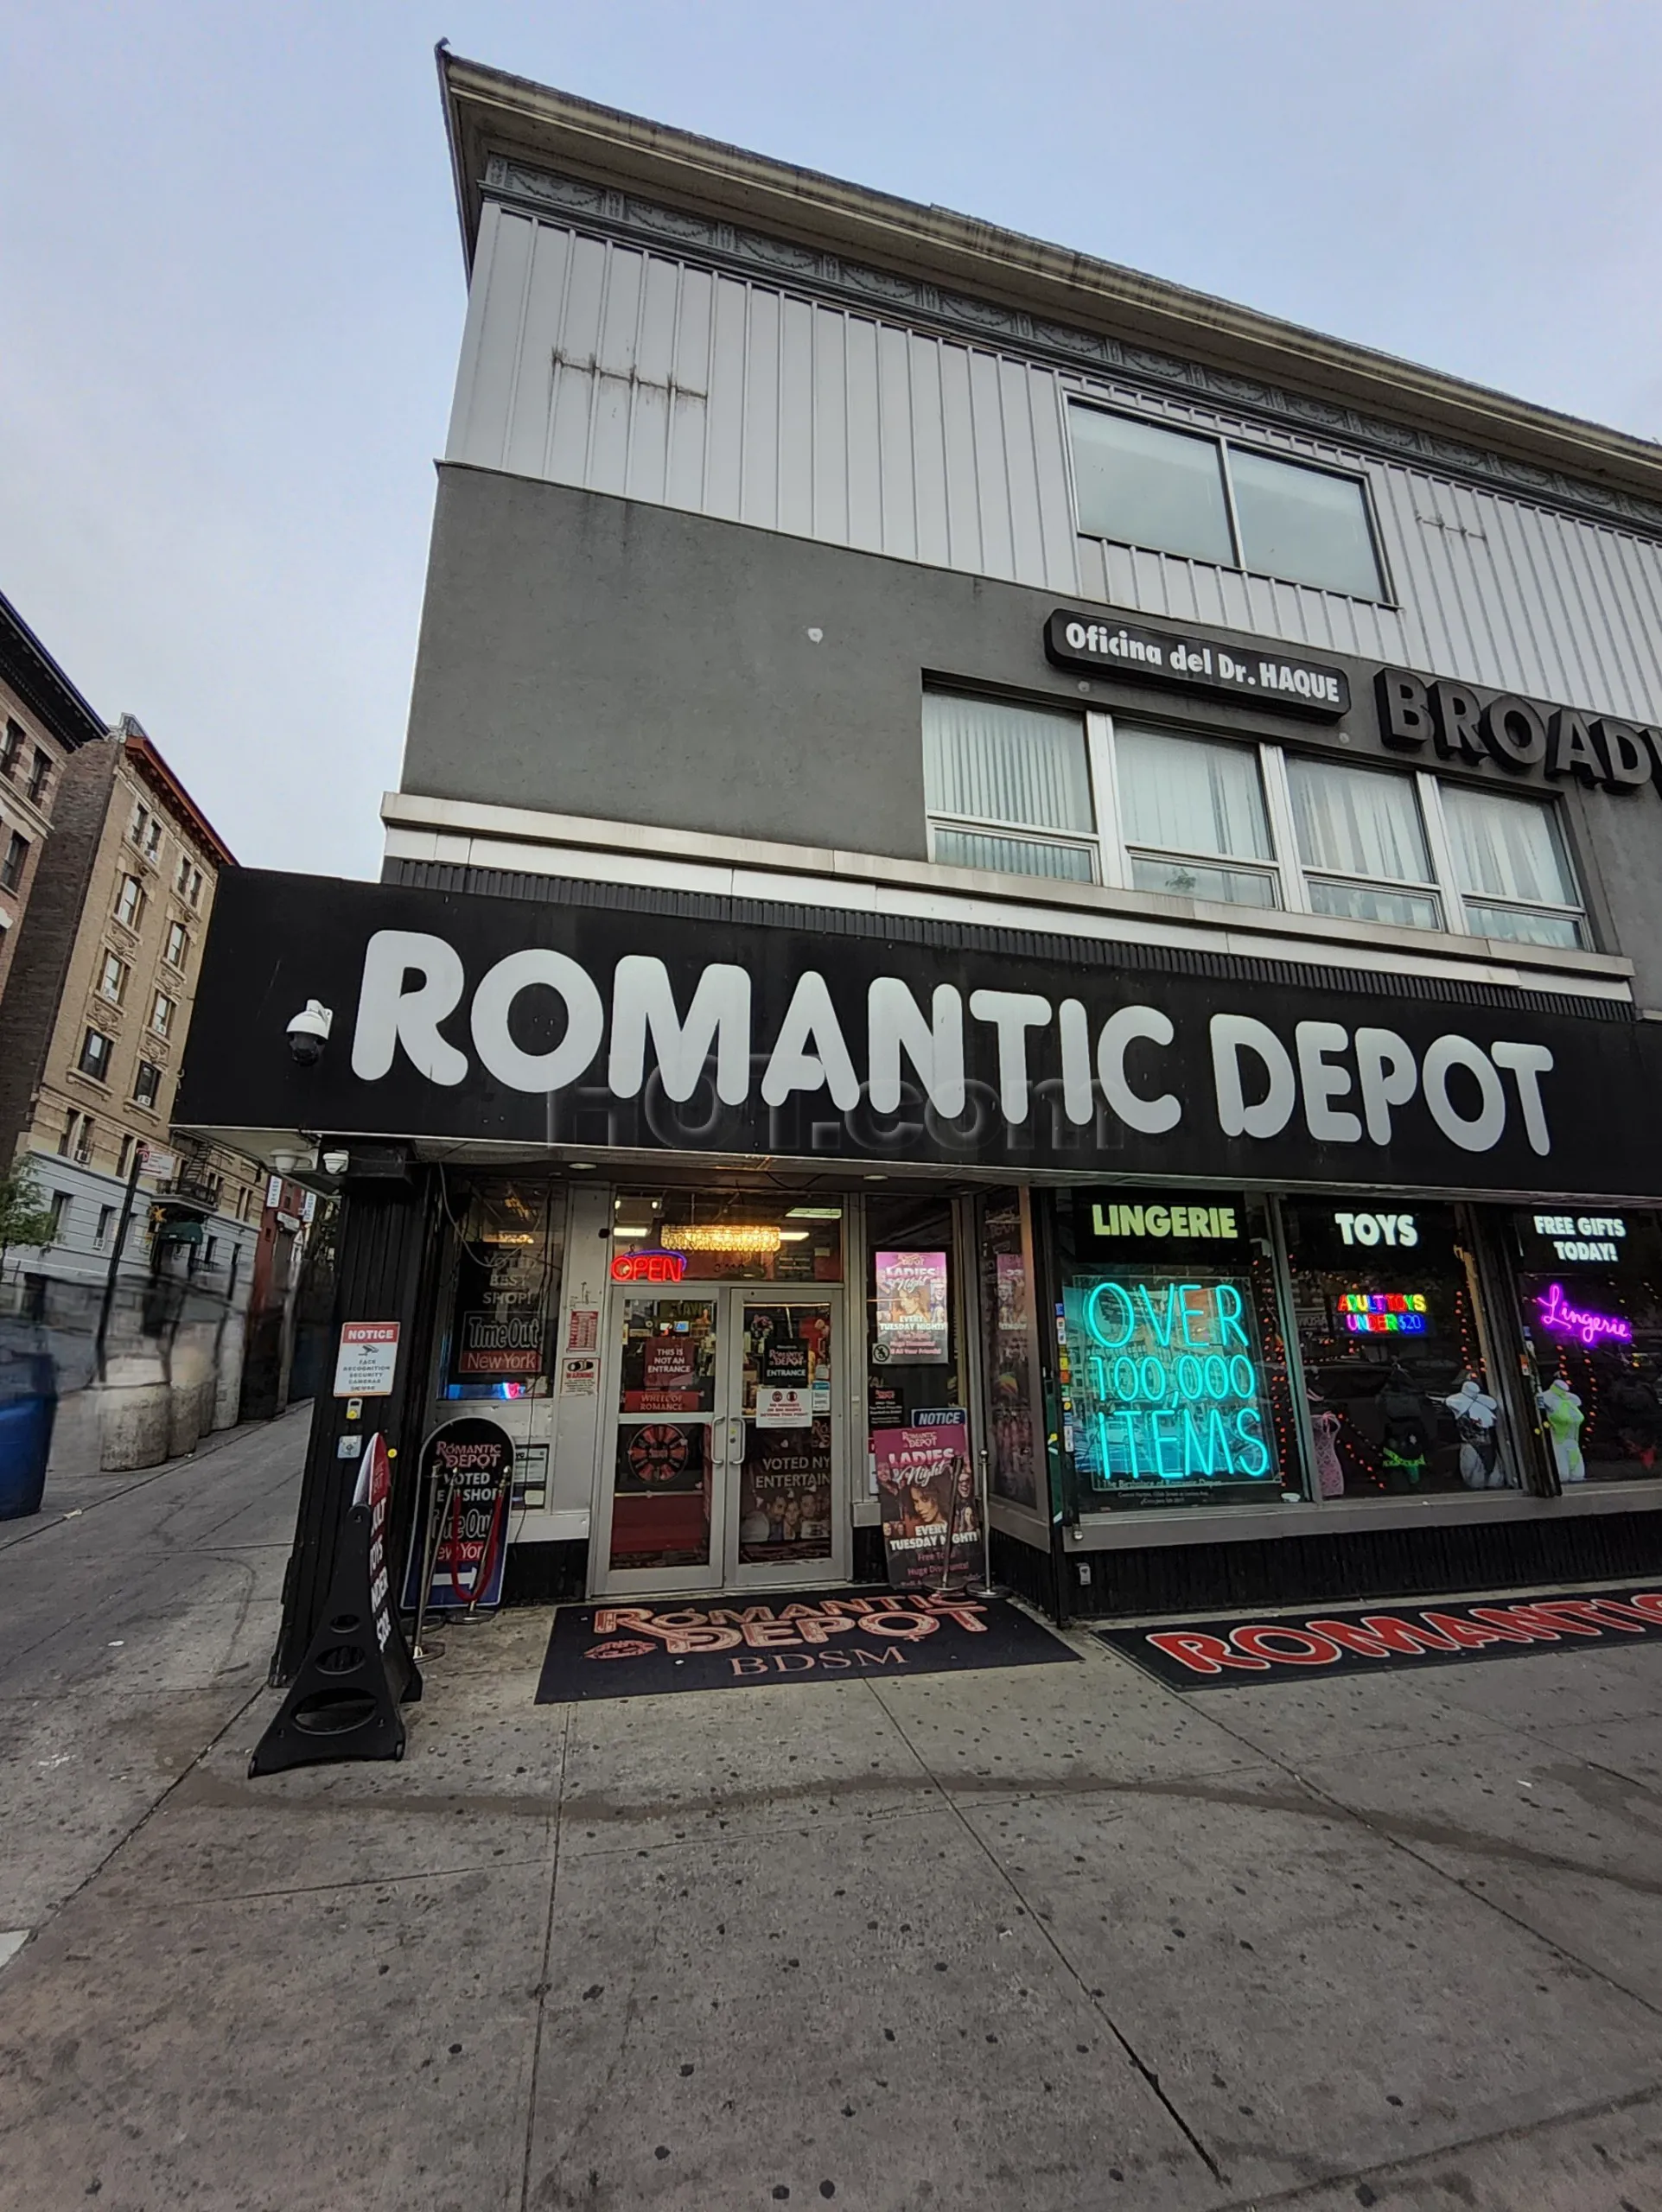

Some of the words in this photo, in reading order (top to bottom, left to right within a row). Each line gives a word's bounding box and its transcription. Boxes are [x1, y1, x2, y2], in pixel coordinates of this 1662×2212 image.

[1065, 621, 1163, 666] Oficina
[1169, 643, 1213, 676] del
[1218, 653, 1256, 689] Dr.
[1259, 662, 1340, 703] HAQUE
[1376, 668, 1662, 794] BROAD
[351, 929, 1182, 1134] ROMANTIC
[1209, 1013, 1554, 1157] DEPOT
[1092, 1205, 1239, 1238] LINGERIE
[1334, 1212, 1419, 1247] TOYS
[1533, 1215, 1576, 1236] FREE
[1578, 1217, 1627, 1238] GIFTS
[1553, 1241, 1619, 1262] TODAY!
[611, 1255, 683, 1283] OPEN
[886, 1267, 937, 1277] LADIES
[488, 1274, 530, 1287] BEST
[1338, 1294, 1386, 1313] ADULT
[1386, 1294, 1428, 1313] TOYS
[1536, 1282, 1633, 1344] Lingerie
[1086, 1282, 1250, 1348] OVER
[1346, 1313, 1398, 1333] UNDER
[1398, 1314, 1423, 1333] $20
[347, 1330, 394, 1340] NOTICE
[880, 1323, 915, 1332] TUESDAY
[466, 1352, 502, 1370] New
[500, 1352, 538, 1370] York
[654, 1357, 671, 1365] NOT
[672, 1357, 685, 1365] AN
[657, 1348, 672, 1357] THIS
[674, 1348, 684, 1357] IS
[647, 1364, 691, 1374] ENTRANCE
[766, 1369, 806, 1377] ENTRANCE
[1088, 1354, 1256, 1409] 100,000
[640, 1402, 684, 1412] ROMANCE
[641, 1394, 669, 1403] WHEEL
[671, 1394, 683, 1402] OF
[919, 1411, 961, 1426] NOTICE
[435, 1440, 501, 1457] ROMANTIC
[908, 1438, 938, 1448] DEPOT
[1098, 1408, 1270, 1480] ITEMS
[446, 1452, 501, 1469] DEPOT
[762, 1455, 810, 1471] VOTED
[888, 1447, 955, 1466] LADIES
[443, 1471, 491, 1486] VOTED
[914, 1523, 948, 1536] EVERY
[889, 1535, 938, 1551] TUESDAY
[939, 1531, 978, 1547] NGHT!
[460, 1542, 485, 1561] Yor
[594, 1592, 978, 1642] ROMANTIC
[665, 1605, 989, 1655] DEPOT
[728, 1644, 910, 1677] BDSM
